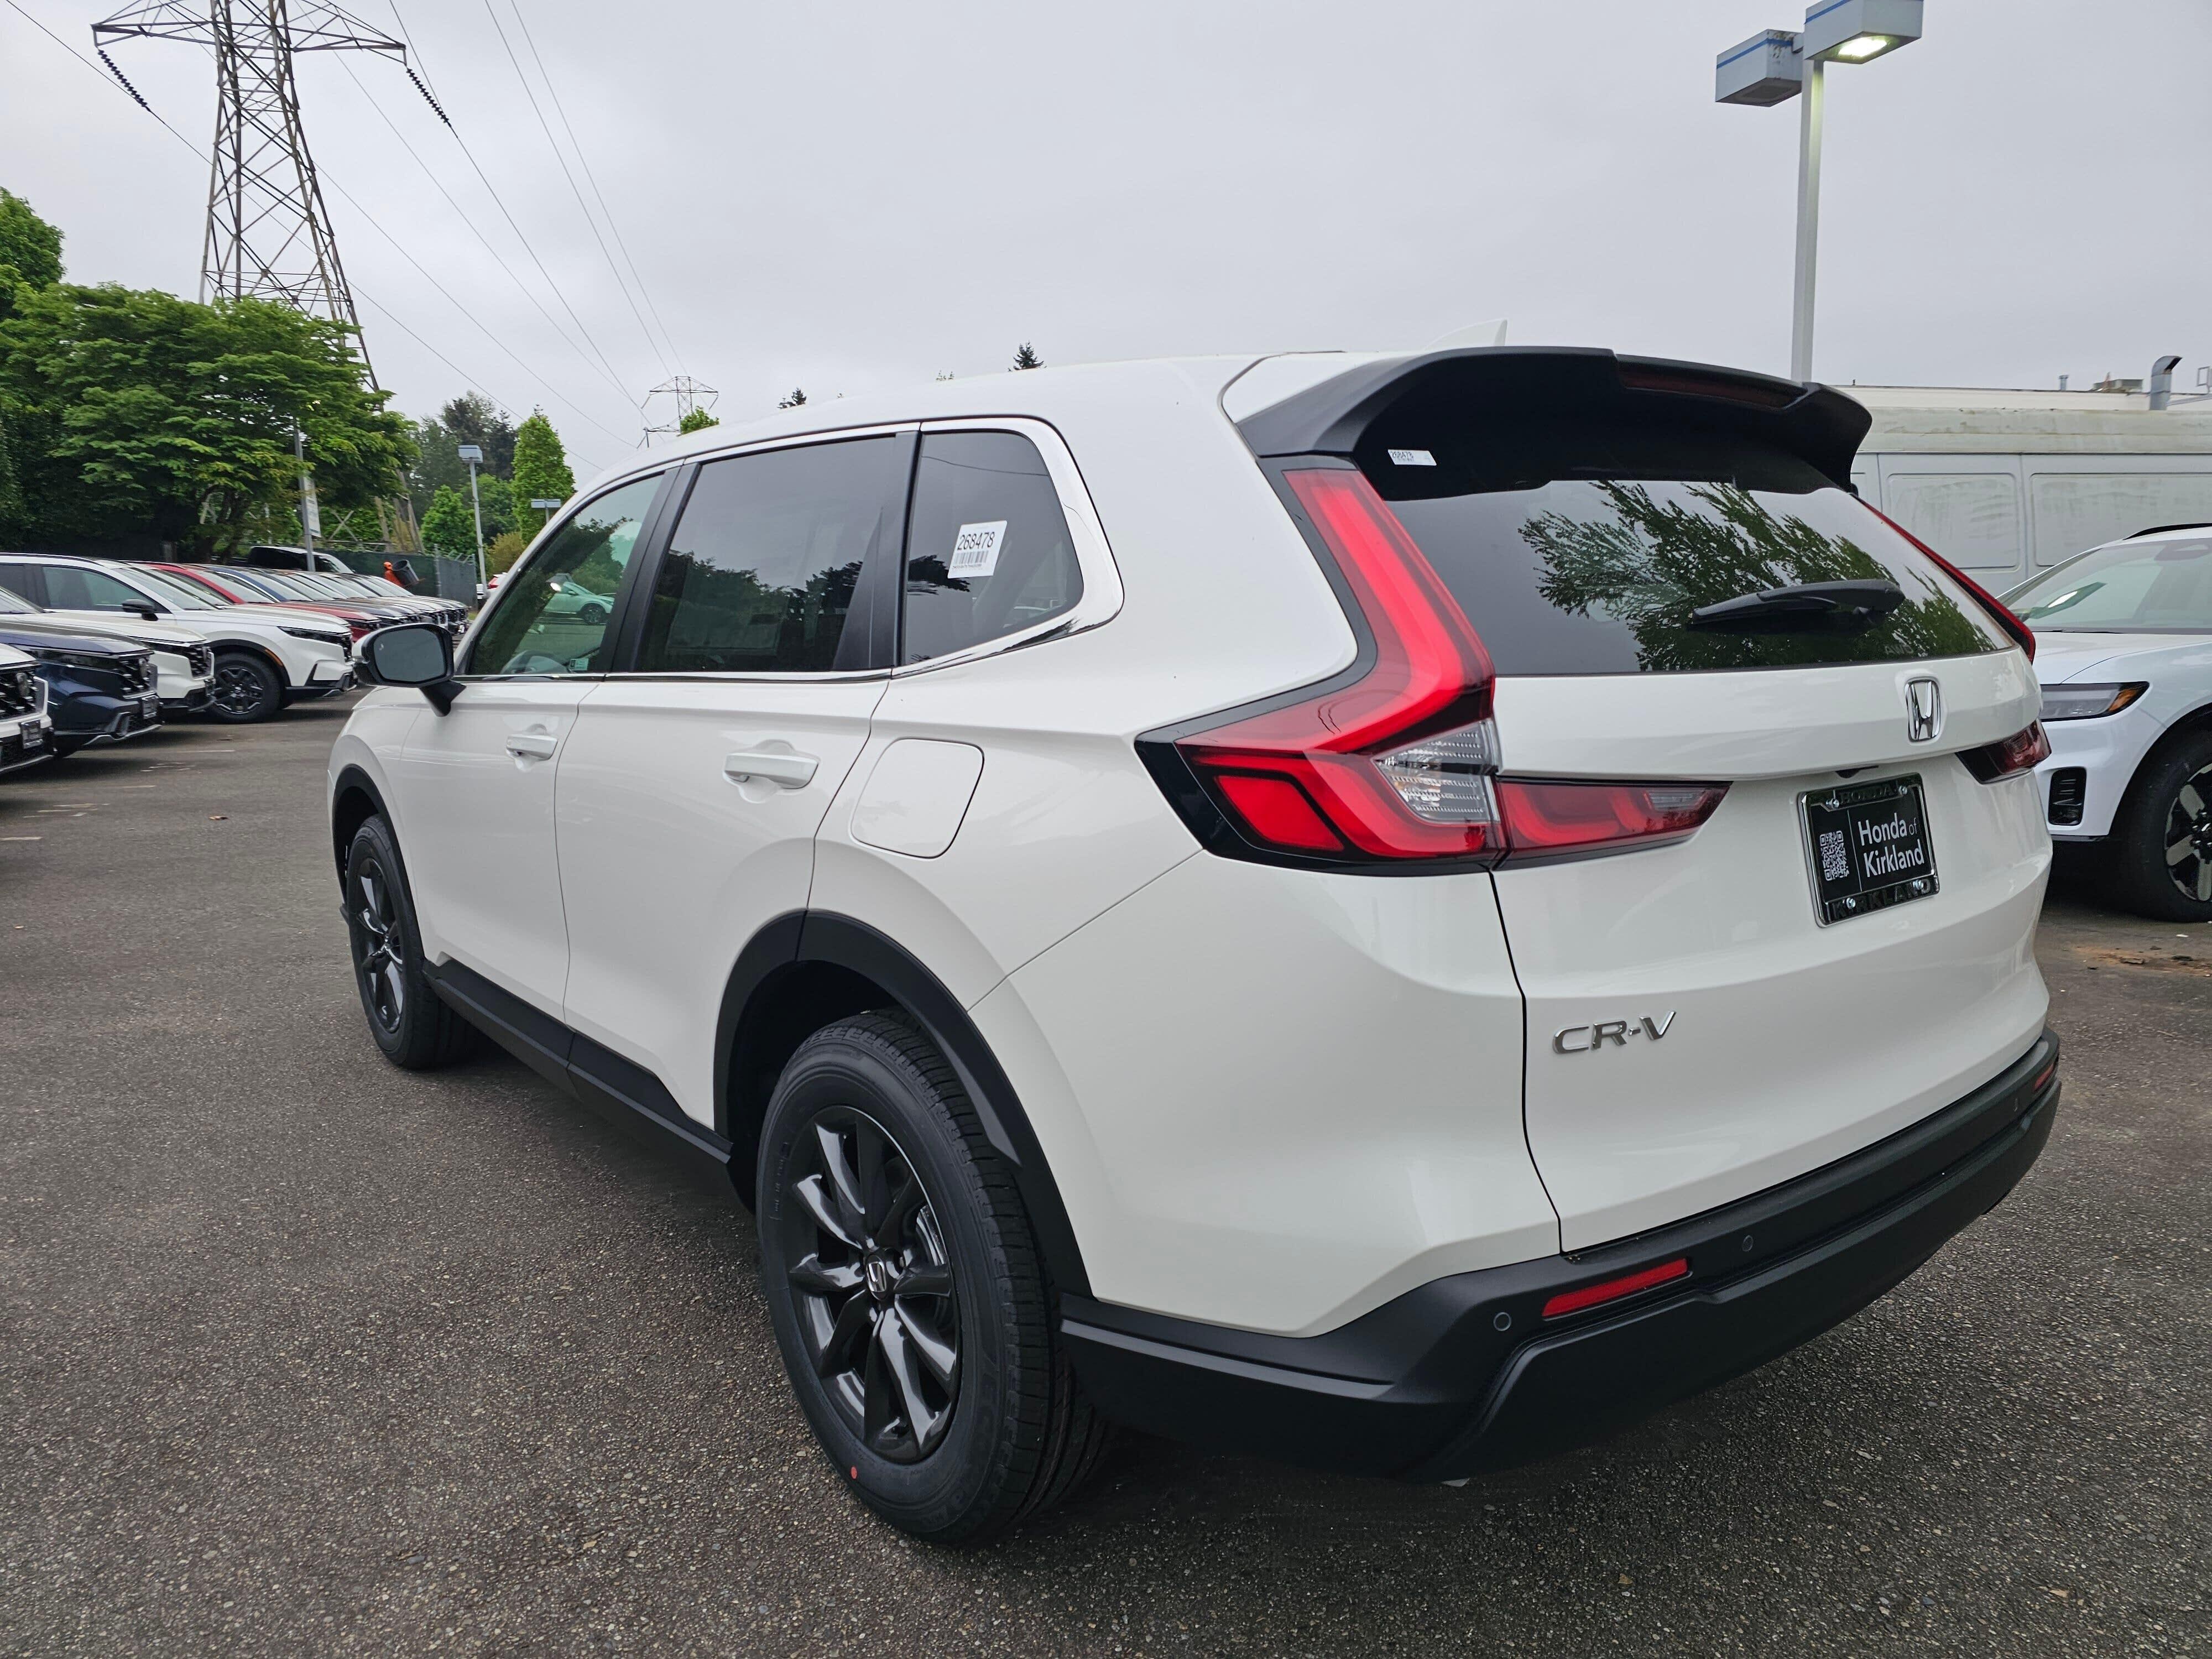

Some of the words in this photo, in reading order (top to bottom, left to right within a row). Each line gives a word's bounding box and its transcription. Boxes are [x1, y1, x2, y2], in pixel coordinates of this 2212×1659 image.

[958, 531, 995, 550] 268478
[1858, 812, 1907, 846] Honda
[1909, 817, 1918, 835] of
[1864, 839, 1924, 877] Kirkland
[1832, 879, 1931, 919] KRKLAND
[1552, 1010, 1676, 1054] CR-V
